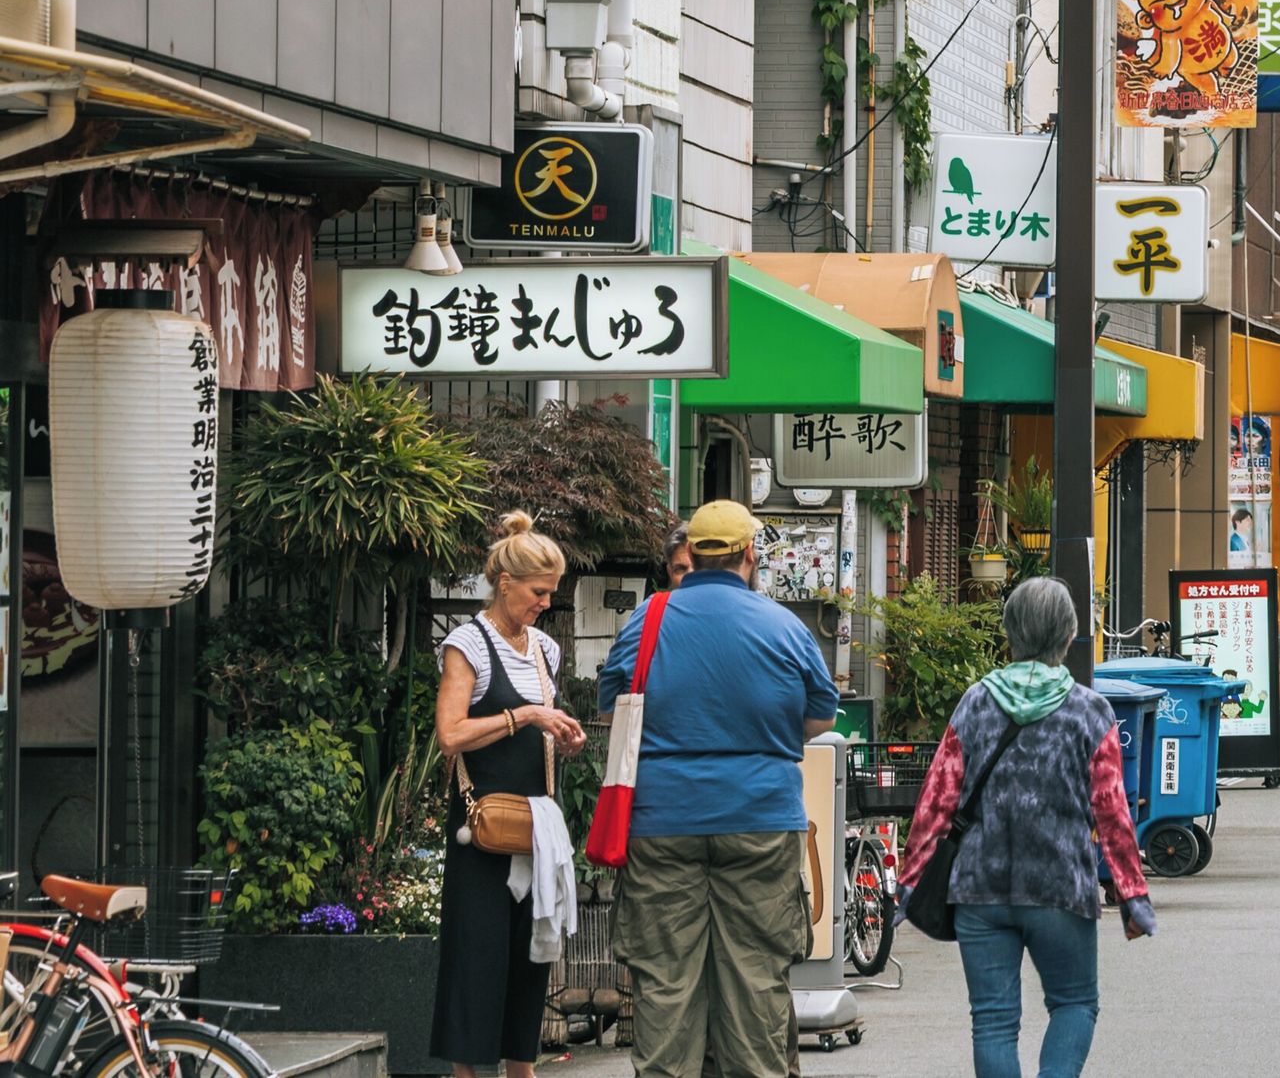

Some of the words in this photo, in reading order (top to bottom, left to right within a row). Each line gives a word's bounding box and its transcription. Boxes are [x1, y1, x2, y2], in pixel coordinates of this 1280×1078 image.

[1119, 91, 1254, 111] 新世界春日通商店会
[509, 224, 595, 238] TENMALU
[940, 207, 1050, 241] とまり木
[1113, 196, 1182, 296] 一平
[372, 273, 686, 368] 釣鐘まんじゅう
[1188, 584, 1260, 597] 処方せん受付中
[1231, 601, 1241, 652] ジェネリック
